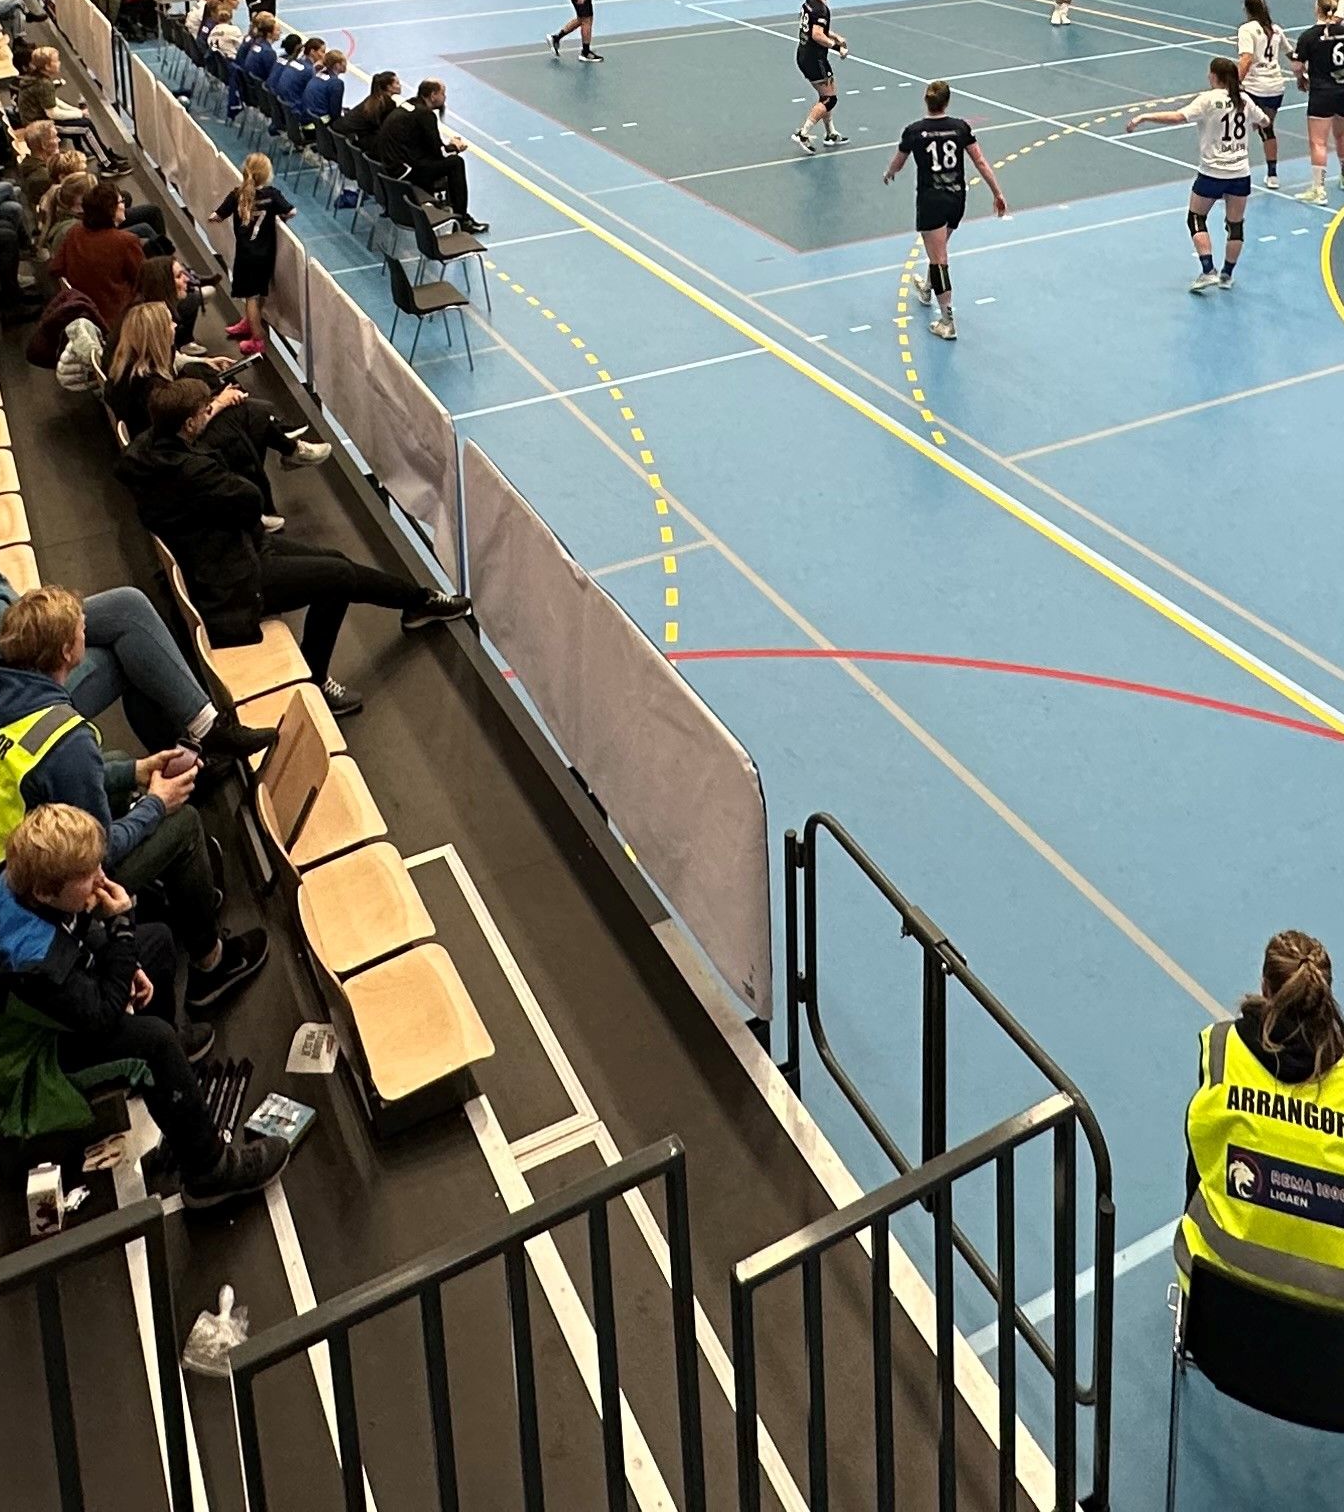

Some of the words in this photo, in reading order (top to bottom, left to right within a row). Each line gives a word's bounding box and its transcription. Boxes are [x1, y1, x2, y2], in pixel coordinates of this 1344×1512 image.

[1264, 40, 1274, 62] 4
[1332, 42, 1344, 66] 6
[1221, 112, 1246, 141] 18
[925, 139, 958, 172] 18
[1270, 1169, 1314, 1195] REMA
[1269, 1190, 1309, 1209] LIGAEN
